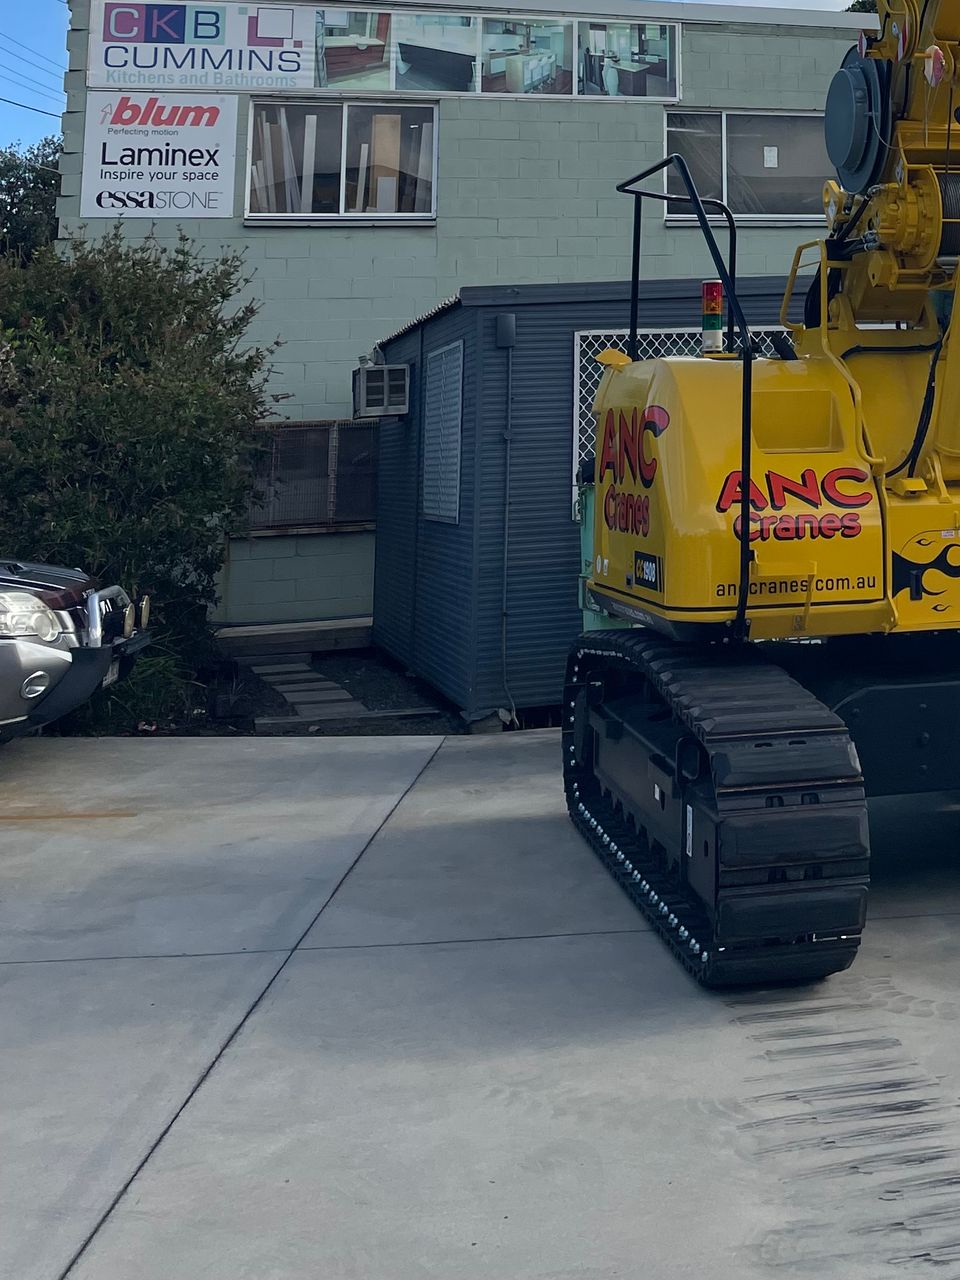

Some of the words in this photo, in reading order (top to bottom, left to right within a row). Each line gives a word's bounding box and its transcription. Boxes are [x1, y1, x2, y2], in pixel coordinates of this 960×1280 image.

[103, 45, 301, 73] CUMMINS
[106, 70, 178, 85] Kitchens
[179, 71, 210, 86] and
[213, 72, 297, 88] Bathrooms
[109, 96, 220, 127] blum
[107, 127, 149, 137] Perfecting
[151, 128, 179, 136] motion
[101, 141, 220, 167] Laminex
[100, 168, 144, 182] Inspire
[148, 171, 178, 182] your
[182, 171, 219, 182] space
[600, 404, 670, 489] ANC
[715, 467, 873, 513] ANC
[604, 483, 651, 538] Cranes
[733, 511, 862, 542] Cranes
[716, 575, 876, 597] ancranescom.au
